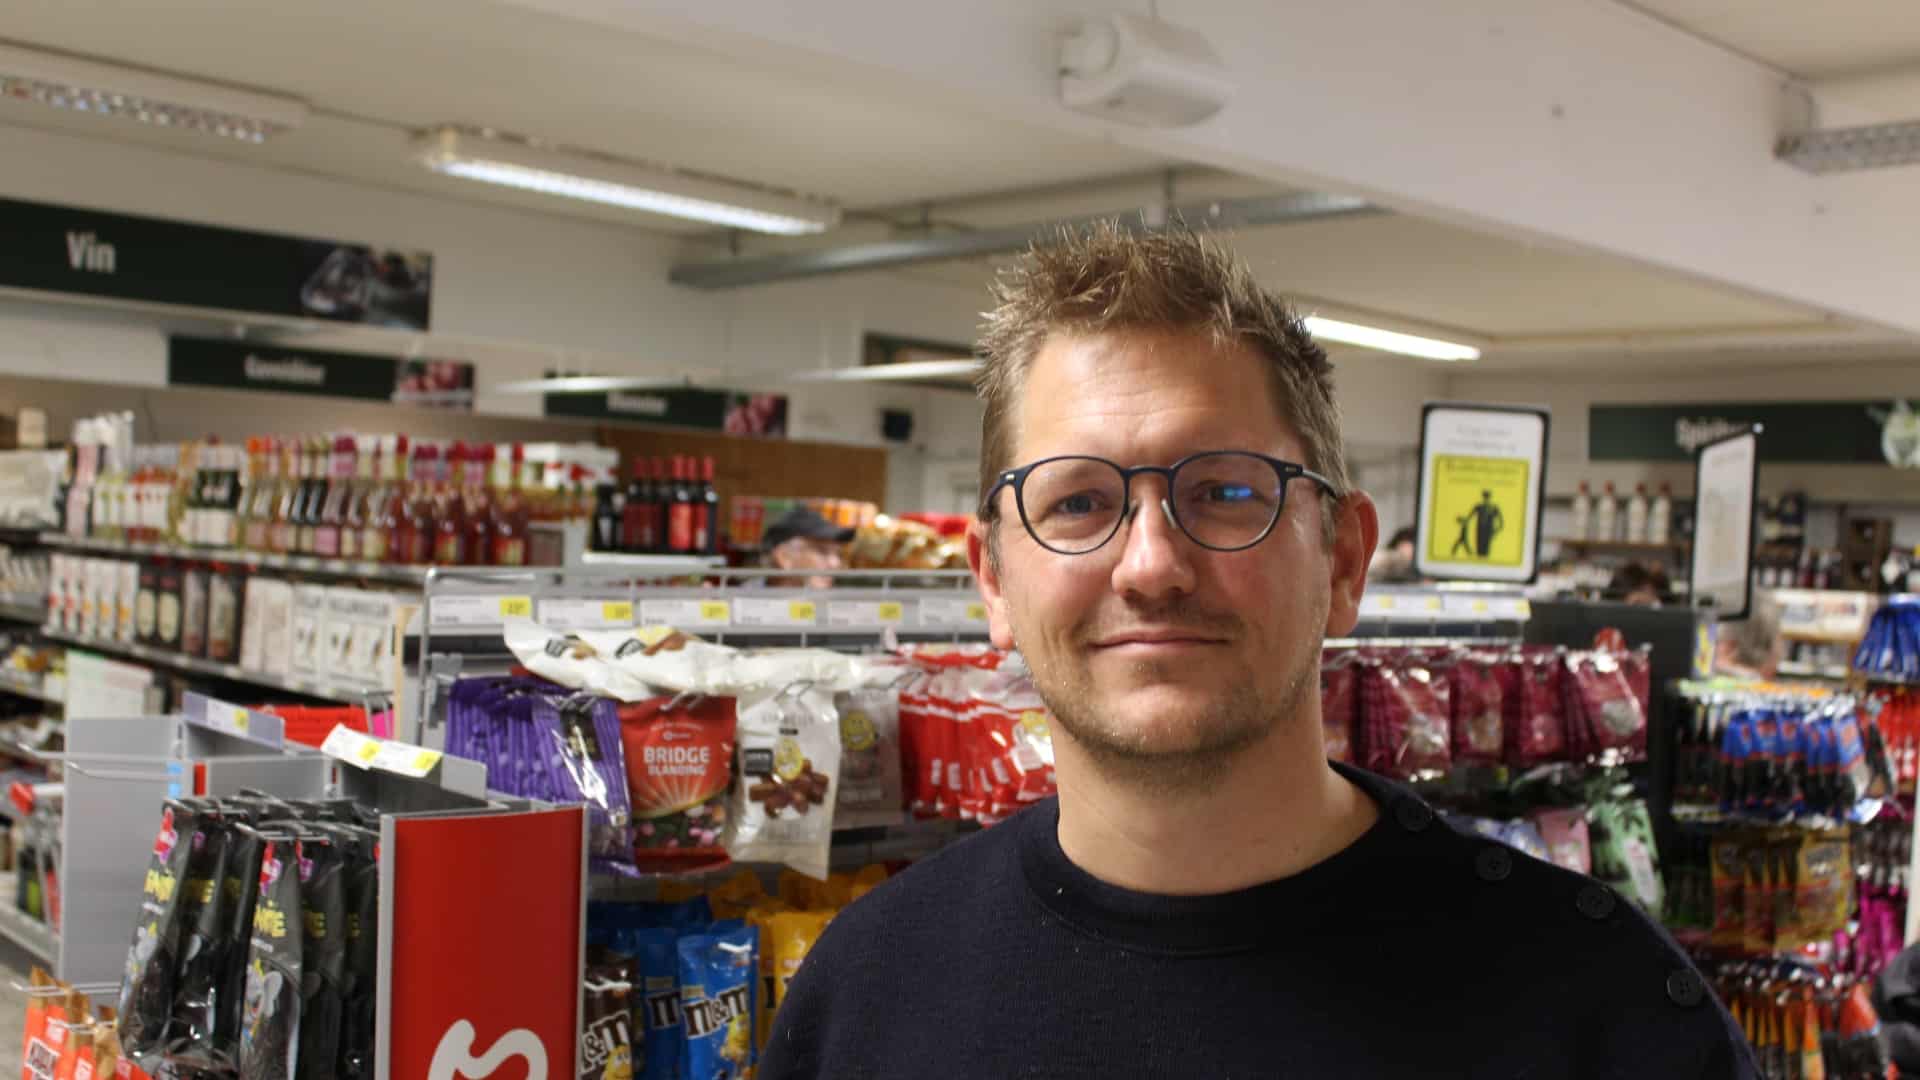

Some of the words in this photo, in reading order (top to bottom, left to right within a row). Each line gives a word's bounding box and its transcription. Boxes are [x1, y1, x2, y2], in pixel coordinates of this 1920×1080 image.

[66, 231, 116, 273] Vin
[643, 746, 711, 765] BRIDGE
[648, 765, 706, 777] BLANDING
